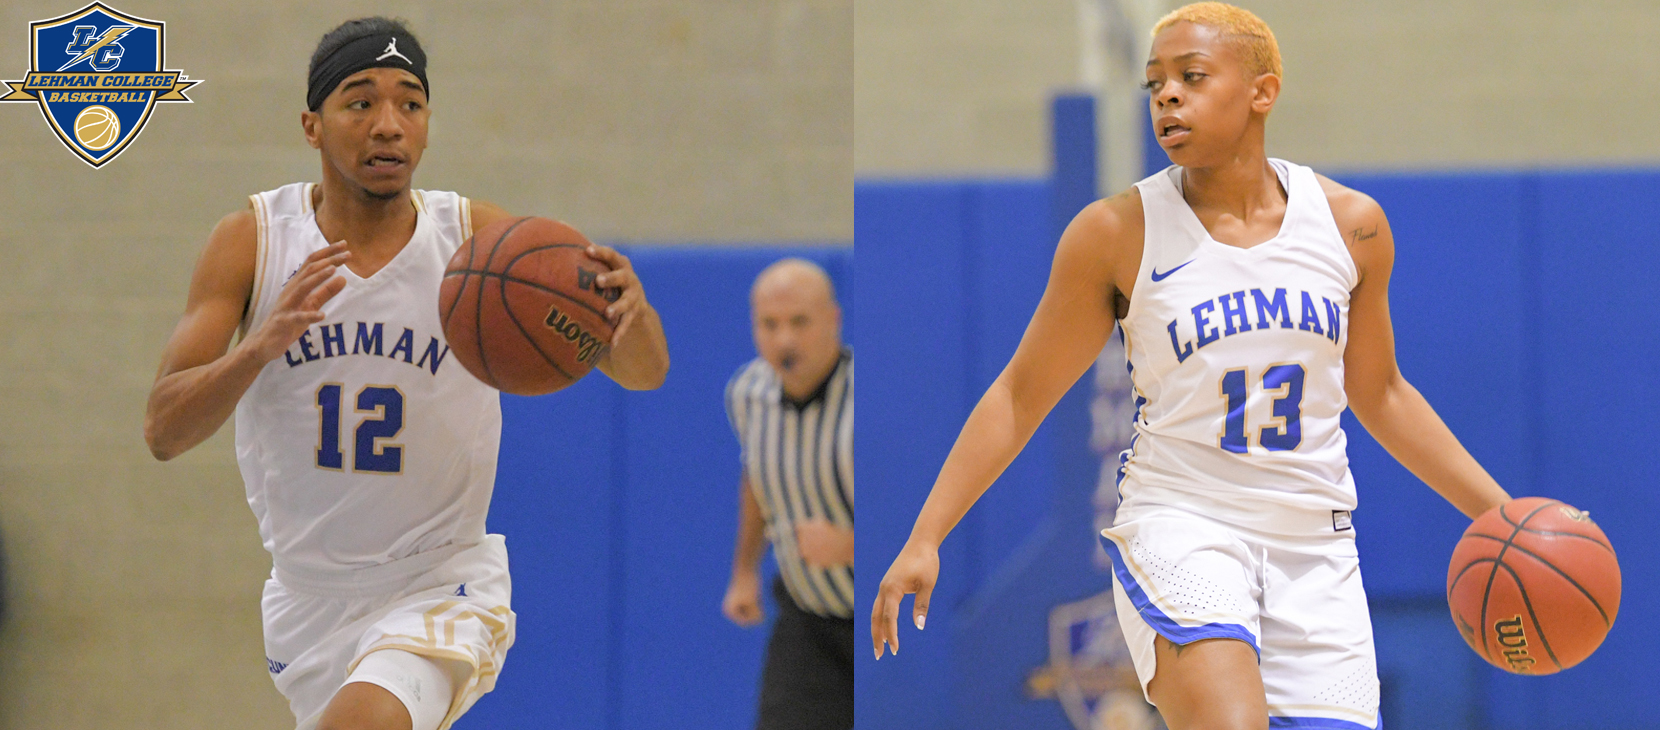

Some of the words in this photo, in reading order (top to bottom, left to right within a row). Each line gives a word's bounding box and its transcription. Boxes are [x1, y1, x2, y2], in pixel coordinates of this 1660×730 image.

[544, 304, 607, 368] ilson
[1167, 287, 1342, 364] LEHMAN
[314, 381, 407, 476] 12
[1217, 360, 1308, 457] 13
